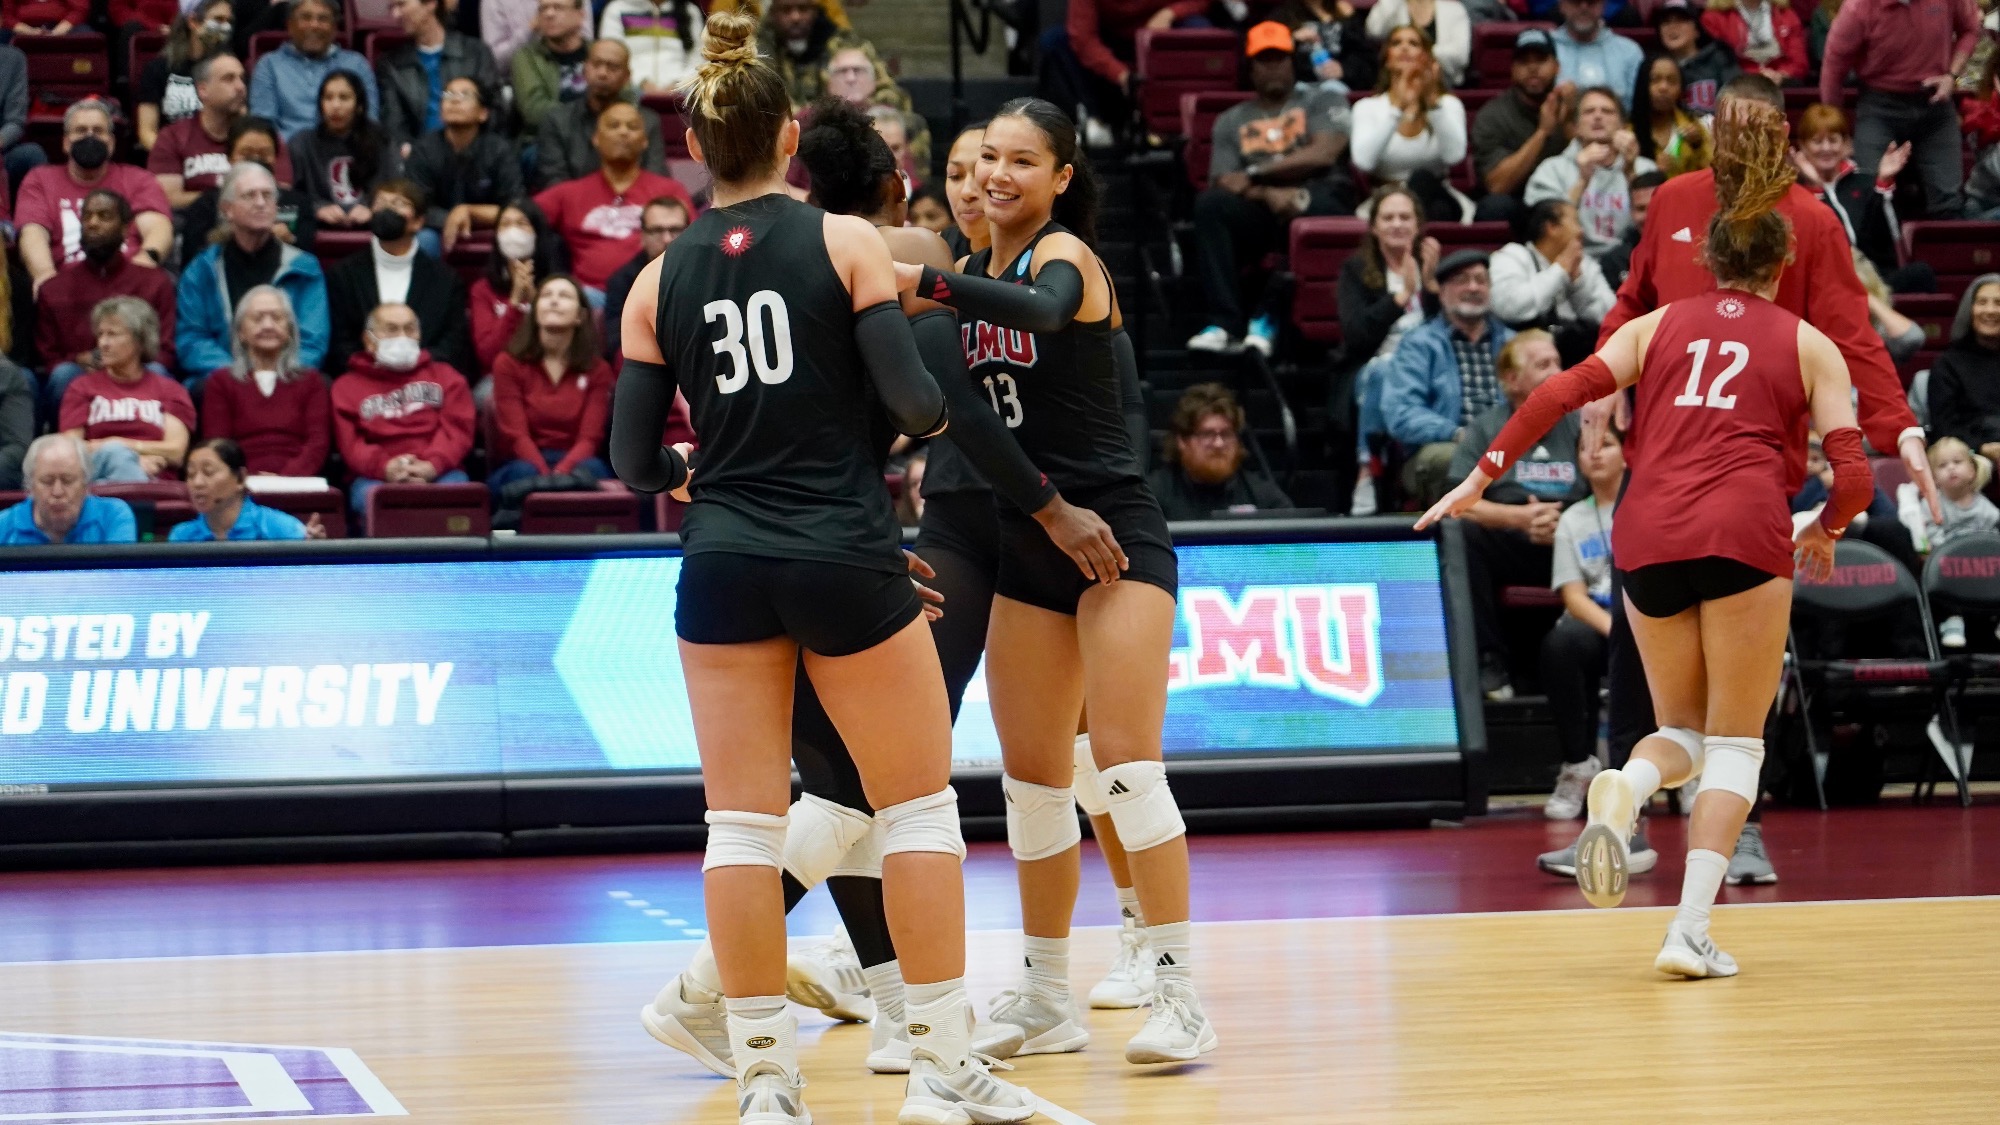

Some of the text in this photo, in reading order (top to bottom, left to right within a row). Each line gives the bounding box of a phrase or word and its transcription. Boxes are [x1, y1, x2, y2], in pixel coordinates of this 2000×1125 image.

[703, 289, 794, 394] 30
[961, 319, 1039, 369] LMU
[982, 372, 1024, 429] 13
[1674, 338, 1750, 410] 12
[1800, 563, 1897, 588] NFORD
[146, 611, 210, 659] BY
[1168, 583, 1384, 706] MU
[0, 662, 454, 734] D UNIVERSITY
